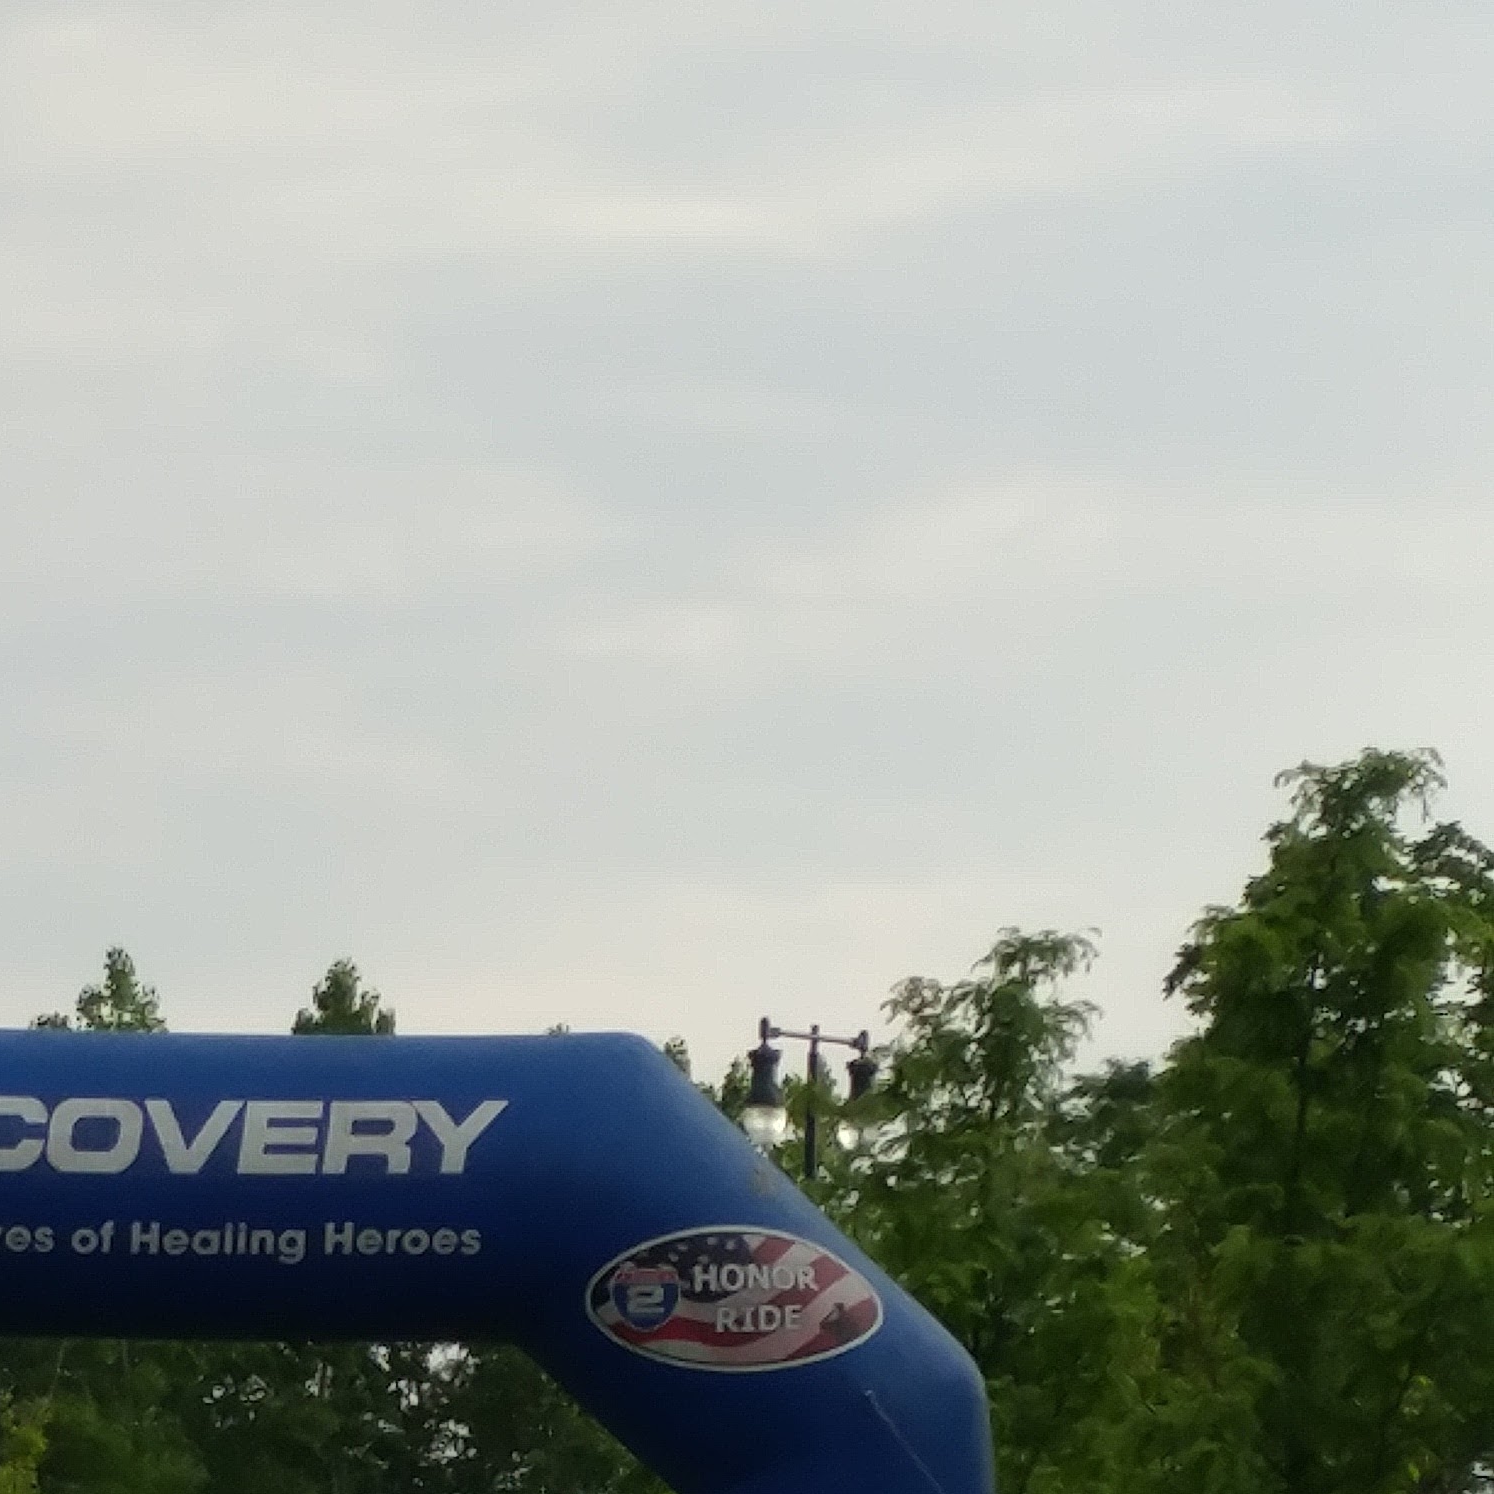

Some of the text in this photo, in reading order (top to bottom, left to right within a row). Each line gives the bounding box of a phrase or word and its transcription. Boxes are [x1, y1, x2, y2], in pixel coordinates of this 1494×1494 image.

[71, 1220, 115, 1254] of
[131, 1221, 306, 1265] Healing
[324, 1222, 482, 1256] Heroes
[693, 1263, 819, 1293] HONOR
[626, 1285, 665, 1314] 2
[715, 1304, 804, 1333] RIDE
